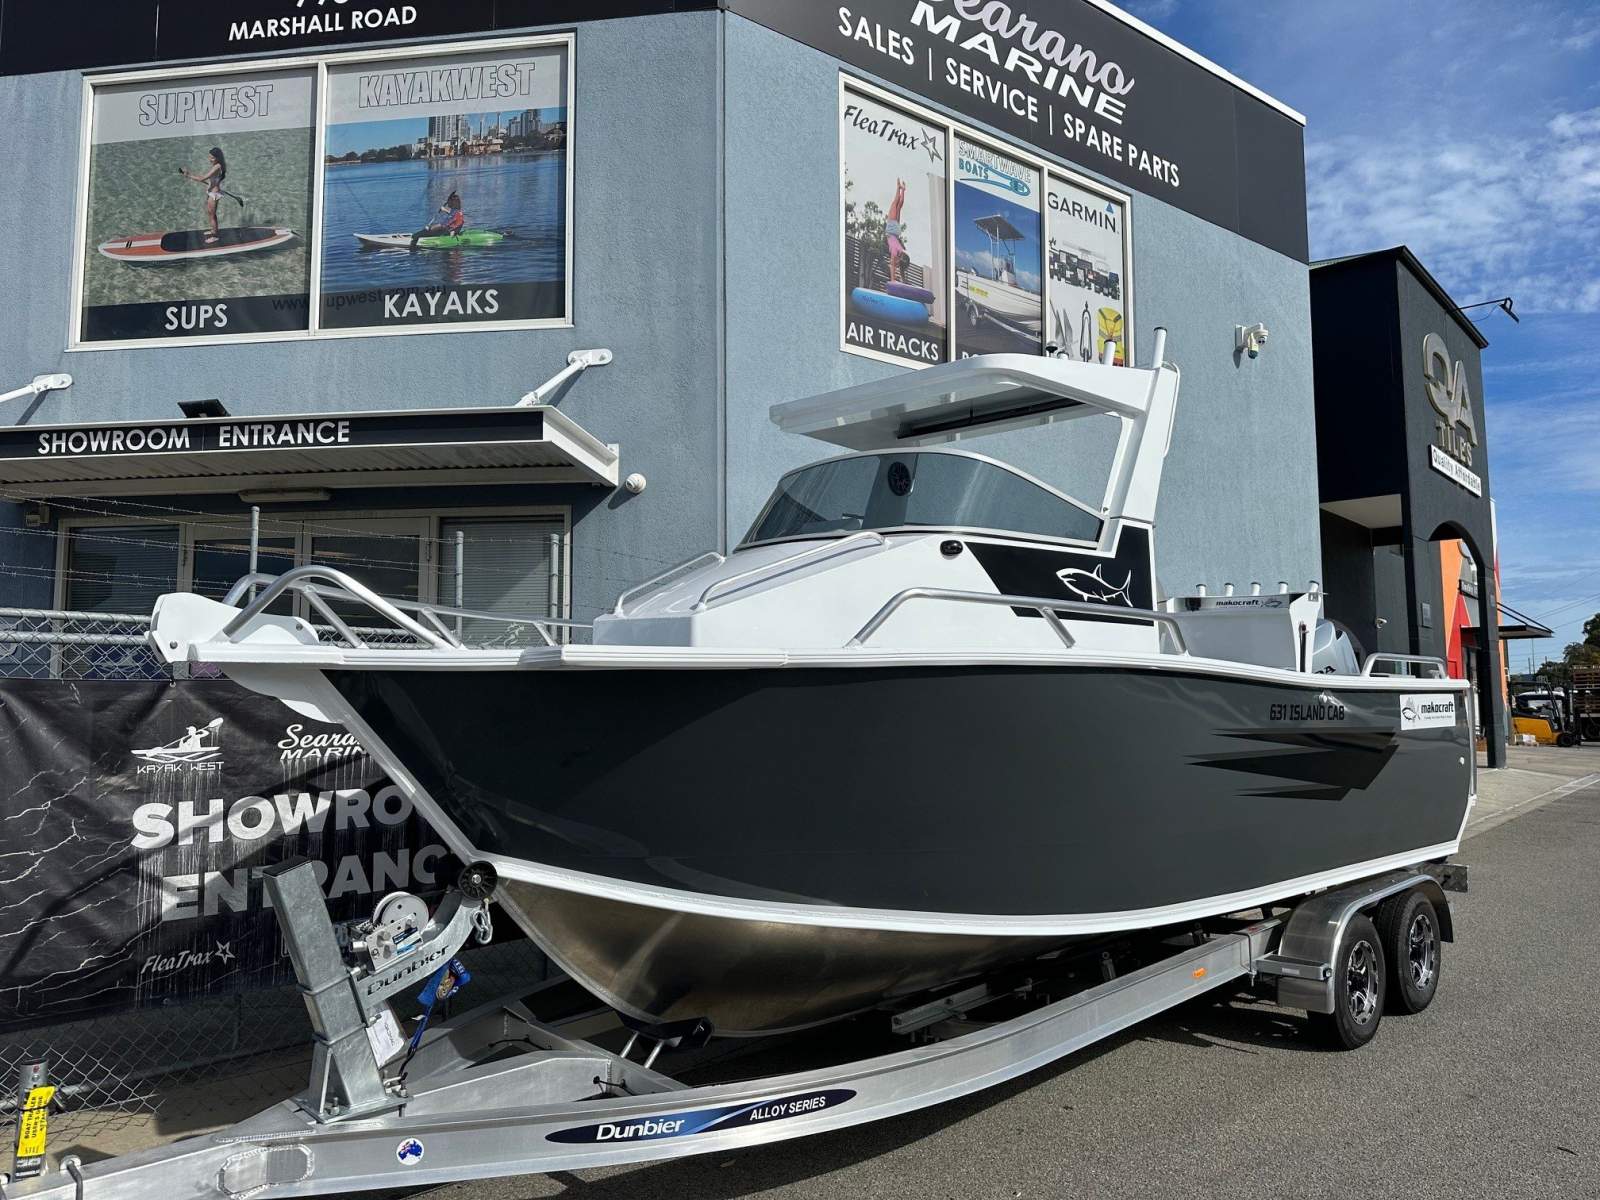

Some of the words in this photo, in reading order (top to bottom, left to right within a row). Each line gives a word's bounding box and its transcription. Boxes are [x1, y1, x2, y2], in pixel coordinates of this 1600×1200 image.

[228, 12, 344, 41] MARSHALL
[351, 6, 417, 29] ROAD
[910, 0, 1126, 125] MARINE
[930, 0, 1135, 95] earano
[358, 63, 535, 108] KAYAKWEST
[838, 7, 915, 65] SALES
[946, 57, 1038, 123] SERVICE
[1063, 113, 1123, 162] SPARE
[1128, 143, 1180, 188] PARTS
[139, 84, 273, 127] SUPWEST
[844, 105, 919, 150] FleaTrax
[959, 158, 989, 180] BOATS
[1048, 191, 1116, 233] GARMIN
[165, 303, 228, 331] SUPS
[384, 289, 499, 318] KAYAKS
[846, 322, 874, 345] AIR
[878, 329, 939, 361] TRACKS
[38, 427, 190, 455] SHOWROOM
[219, 421, 350, 447] ENTRANCE
[1436, 420, 1473, 467] TILES
[1433, 448, 1453, 475] Quality
[1454, 464, 1481, 491] Affordable
[1216, 599, 1259, 607] makocraft
[1270, 704, 1287, 720] 631
[1289, 704, 1325, 720] ISLAND
[1327, 705, 1345, 720] CAB
[1421, 701, 1454, 713] makocraft
[277, 723, 361, 749] Seara
[280, 746, 367, 760] MARIN
[137, 763, 183, 774] KAYAK
[190, 762, 224, 771] WEST
[130, 785, 413, 849] SHOWRO
[141, 949, 214, 974] FleaTrax
[367, 945, 449, 996] Dunbier
[596, 1117, 685, 1141] Dunbier
[750, 1105, 787, 1121] ALLOY
[789, 1096, 826, 1114] SERIES
